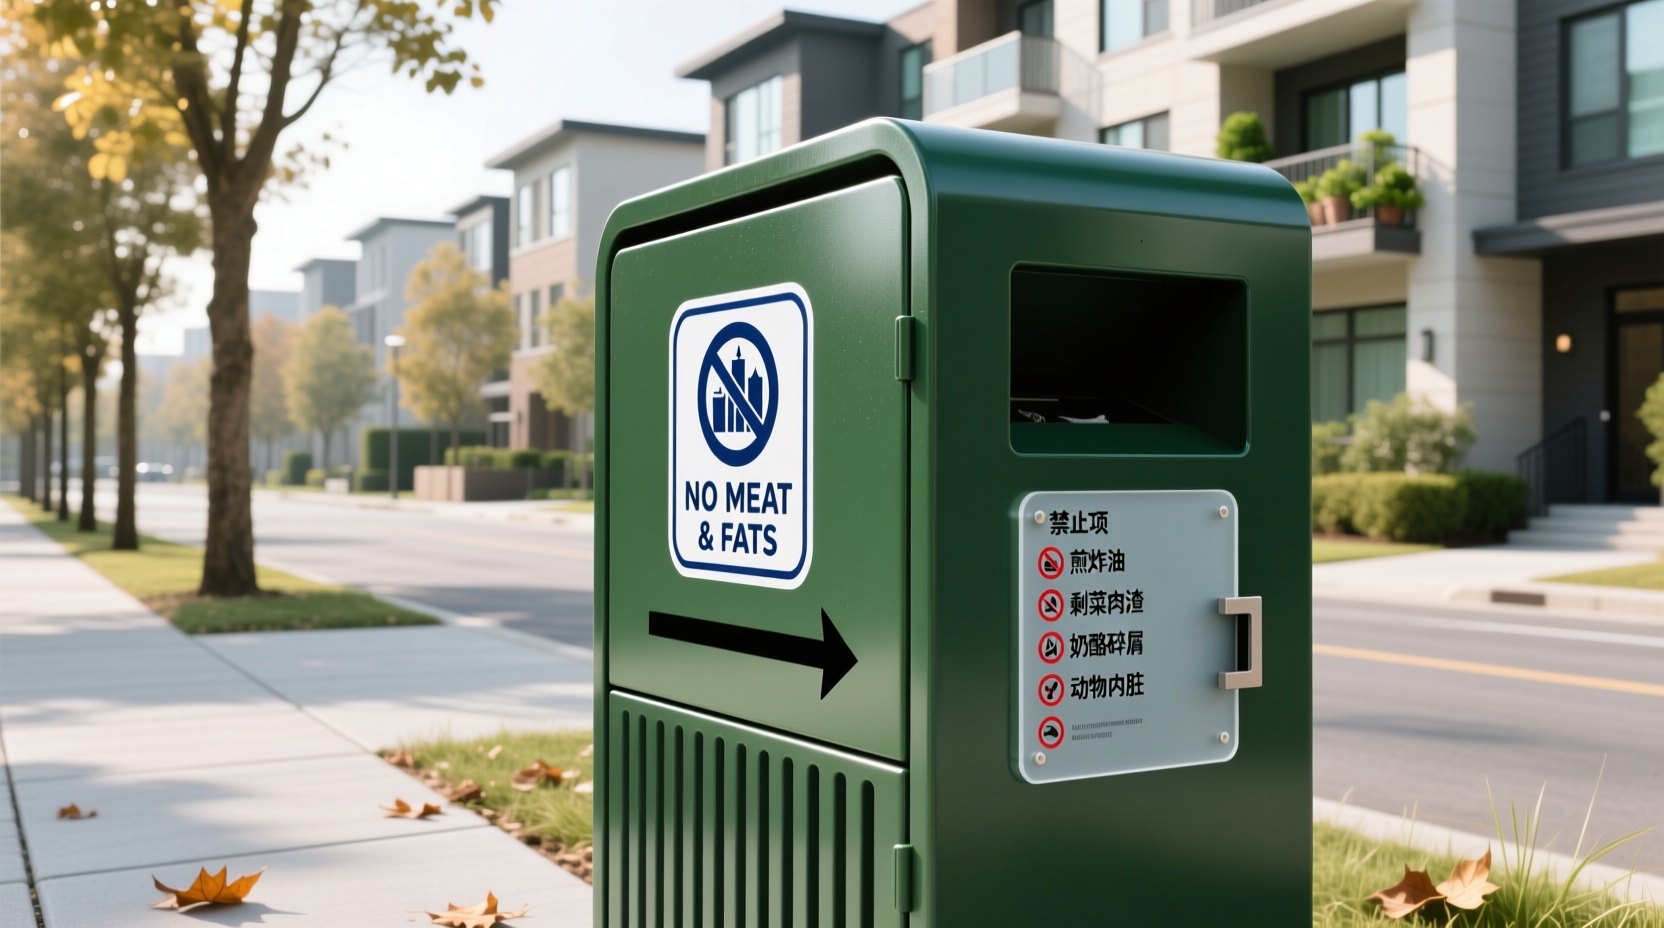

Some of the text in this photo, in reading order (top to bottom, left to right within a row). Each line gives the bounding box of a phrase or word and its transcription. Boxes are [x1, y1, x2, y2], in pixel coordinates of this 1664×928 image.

[686, 481, 793, 515] NO MEAT
[1050, 510, 1109, 536] 禁止项
[699, 521, 778, 557] & FATS
[1070, 549, 1126, 575] 煎炸油
[1070, 589, 1145, 617] 剩菜肉渣
[1070, 631, 1144, 659] 奶酪碎屑
[1070, 672, 1145, 701] 动物内脏
